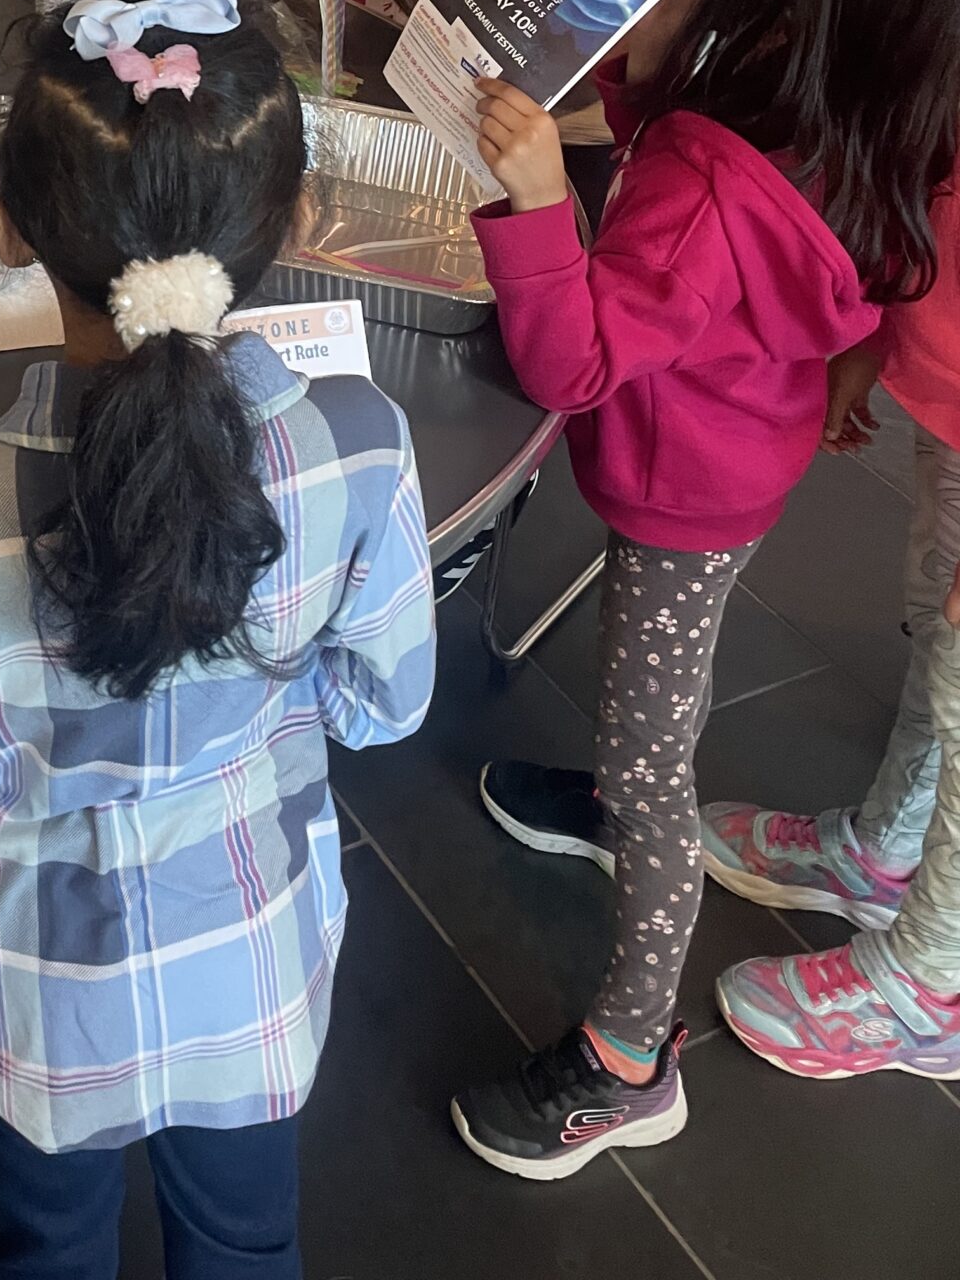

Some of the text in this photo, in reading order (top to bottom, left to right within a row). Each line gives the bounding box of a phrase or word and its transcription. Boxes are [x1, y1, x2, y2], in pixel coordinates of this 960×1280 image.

[472, 6, 498, 35] FAMILY
[492, 30, 529, 69] FESTIVAL
[508, 9, 539, 39] 10th
[295, 344, 329, 360] Rate
